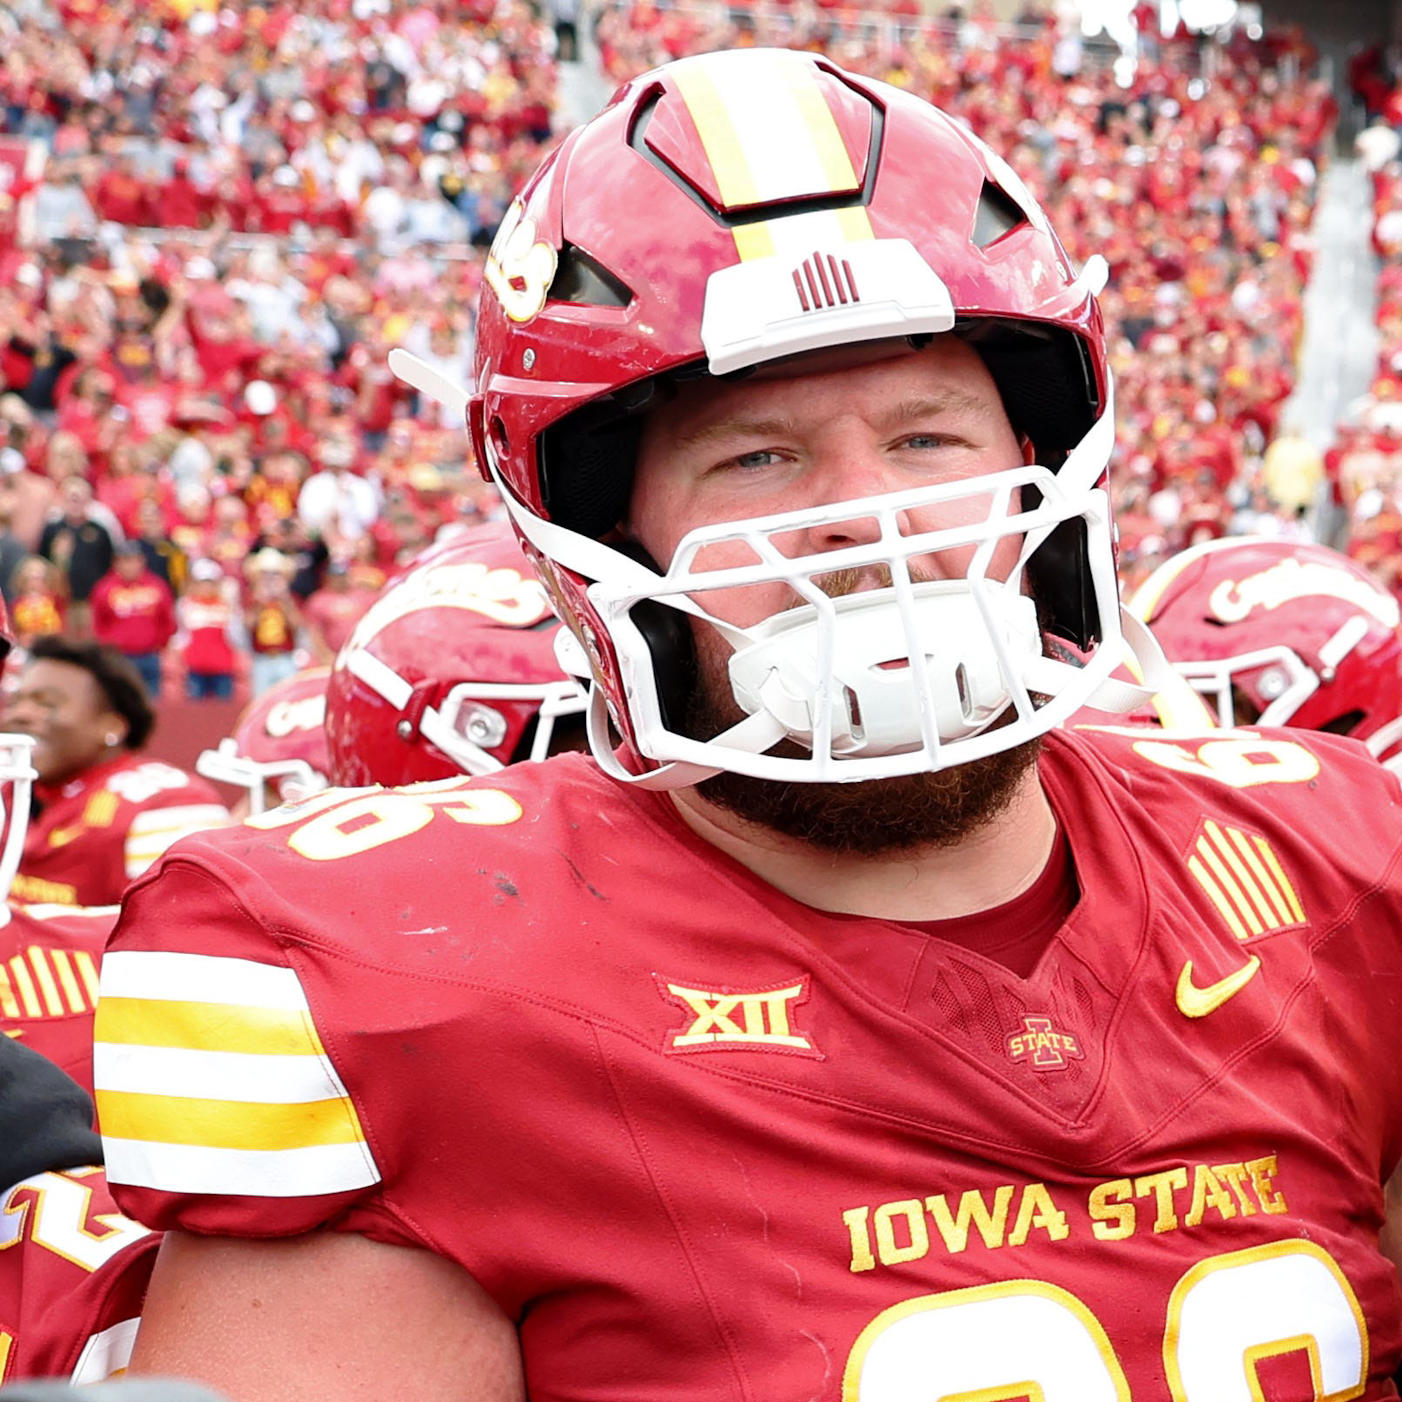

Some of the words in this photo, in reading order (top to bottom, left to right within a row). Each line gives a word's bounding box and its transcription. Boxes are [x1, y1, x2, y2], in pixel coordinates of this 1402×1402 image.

[666, 983, 812, 1049] XII
[1010, 1032, 1077, 1056] STATE
[842, 1184, 1070, 1273] IOWA
[1087, 1155, 1288, 1241] STATE
